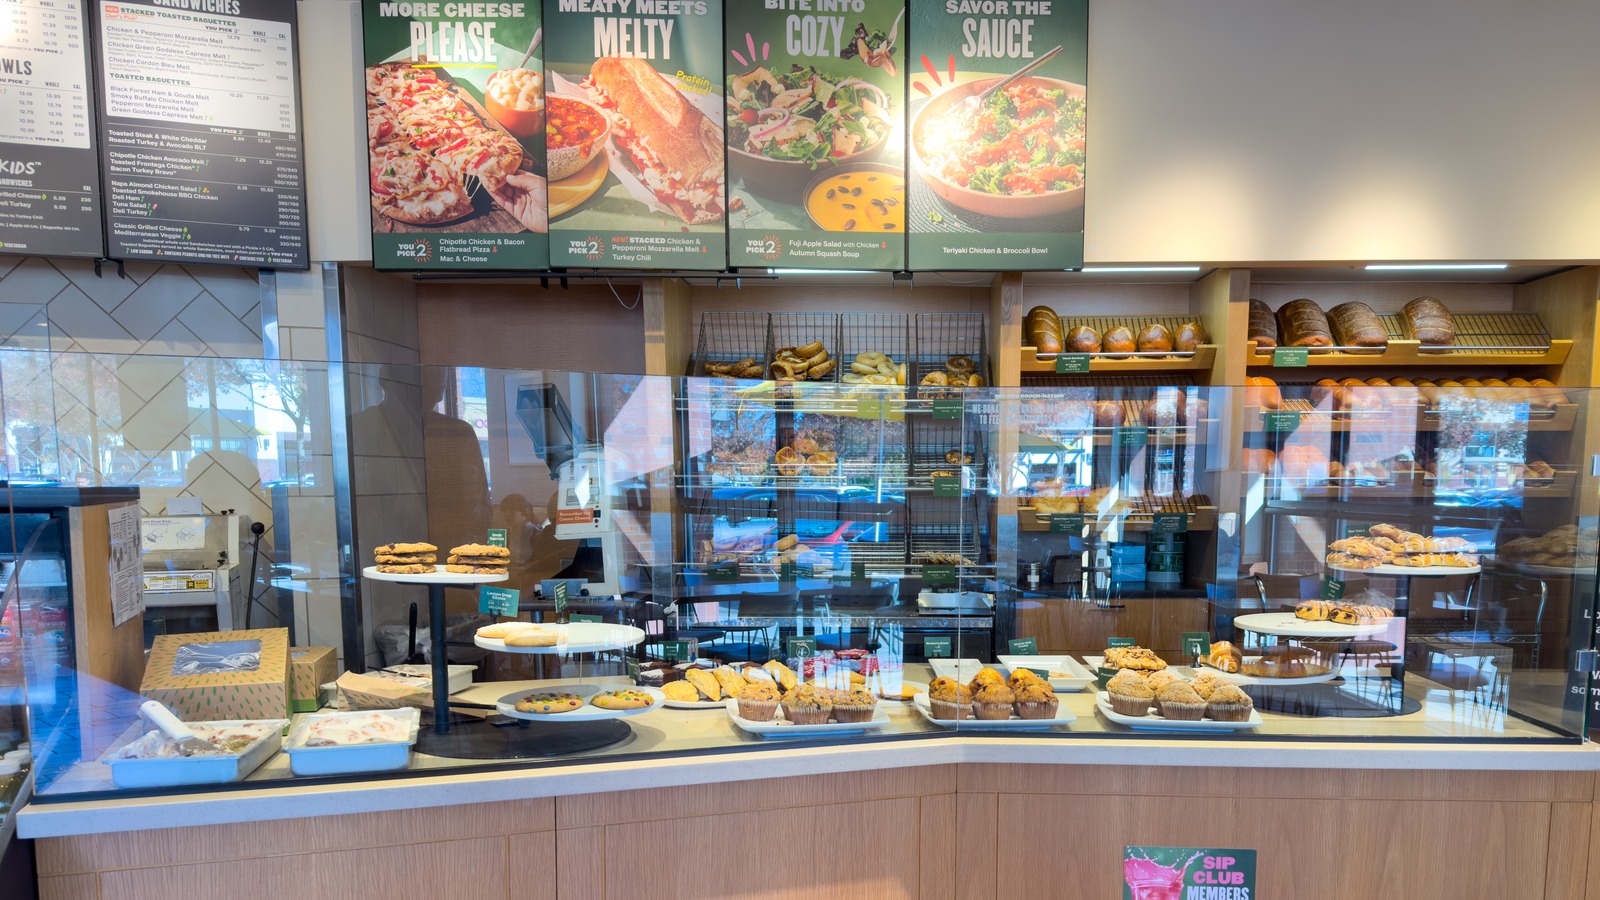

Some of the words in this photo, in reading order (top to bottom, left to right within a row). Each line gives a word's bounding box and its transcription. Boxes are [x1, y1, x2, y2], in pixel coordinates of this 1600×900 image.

[153, 0, 240, 15] DWICHES
[380, 2, 440, 16] MORE
[444, 2, 525, 18] CHEESE
[558, 0, 632, 14] MEATY
[636, 0, 708, 15] MEETS
[764, 0, 812, 10] BITE
[817, 0, 865, 12] INTO
[946, 0, 1009, 14] SAVOR
[1012, 1, 1052, 15] THE
[120, 8, 155, 16] STACKED
[157, 12, 192, 20] TOASTED
[193, 16, 236, 26] BAGUETTES
[140, 29, 174, 38] Pepperoni
[174, 34, 208, 42] Mozzarella
[410, 21, 497, 63] PLEASE
[594, 17, 674, 60] MELTY
[786, 14, 845, 58] COZY
[962, 18, 1034, 58] SAUCE
[156, 46, 184, 54] Goddess
[0, 58, 32, 76] WLS
[146, 76, 190, 86] BAGUETTES
[676, 70, 710, 86] Protein
[112, 100, 144, 108] Pepperoni
[162, 111, 188, 119] Caprese
[137, 160, 166, 169] Frontega
[138, 189, 178, 198] Smokehouse
[114, 230, 160, 238] Mediterranean
[160, 232, 181, 240] Veggie
[440, 238, 467, 246] Chipotle
[588, 242, 598, 255] 2
[766, 241, 776, 256] 2
[790, 240, 802, 248] Fuji
[802, 240, 822, 248] Apple
[416, 244, 426, 256] 2
[612, 245, 646, 253] Pepperoni
[842, 250, 860, 258] Soup
[942, 247, 968, 255] Teriyaki
[980, 415, 987, 424] TO
[1203, 856, 1236, 870] SIP
[1193, 871, 1245, 885] CLUB
[1187, 886, 1250, 900] MEMBERS
